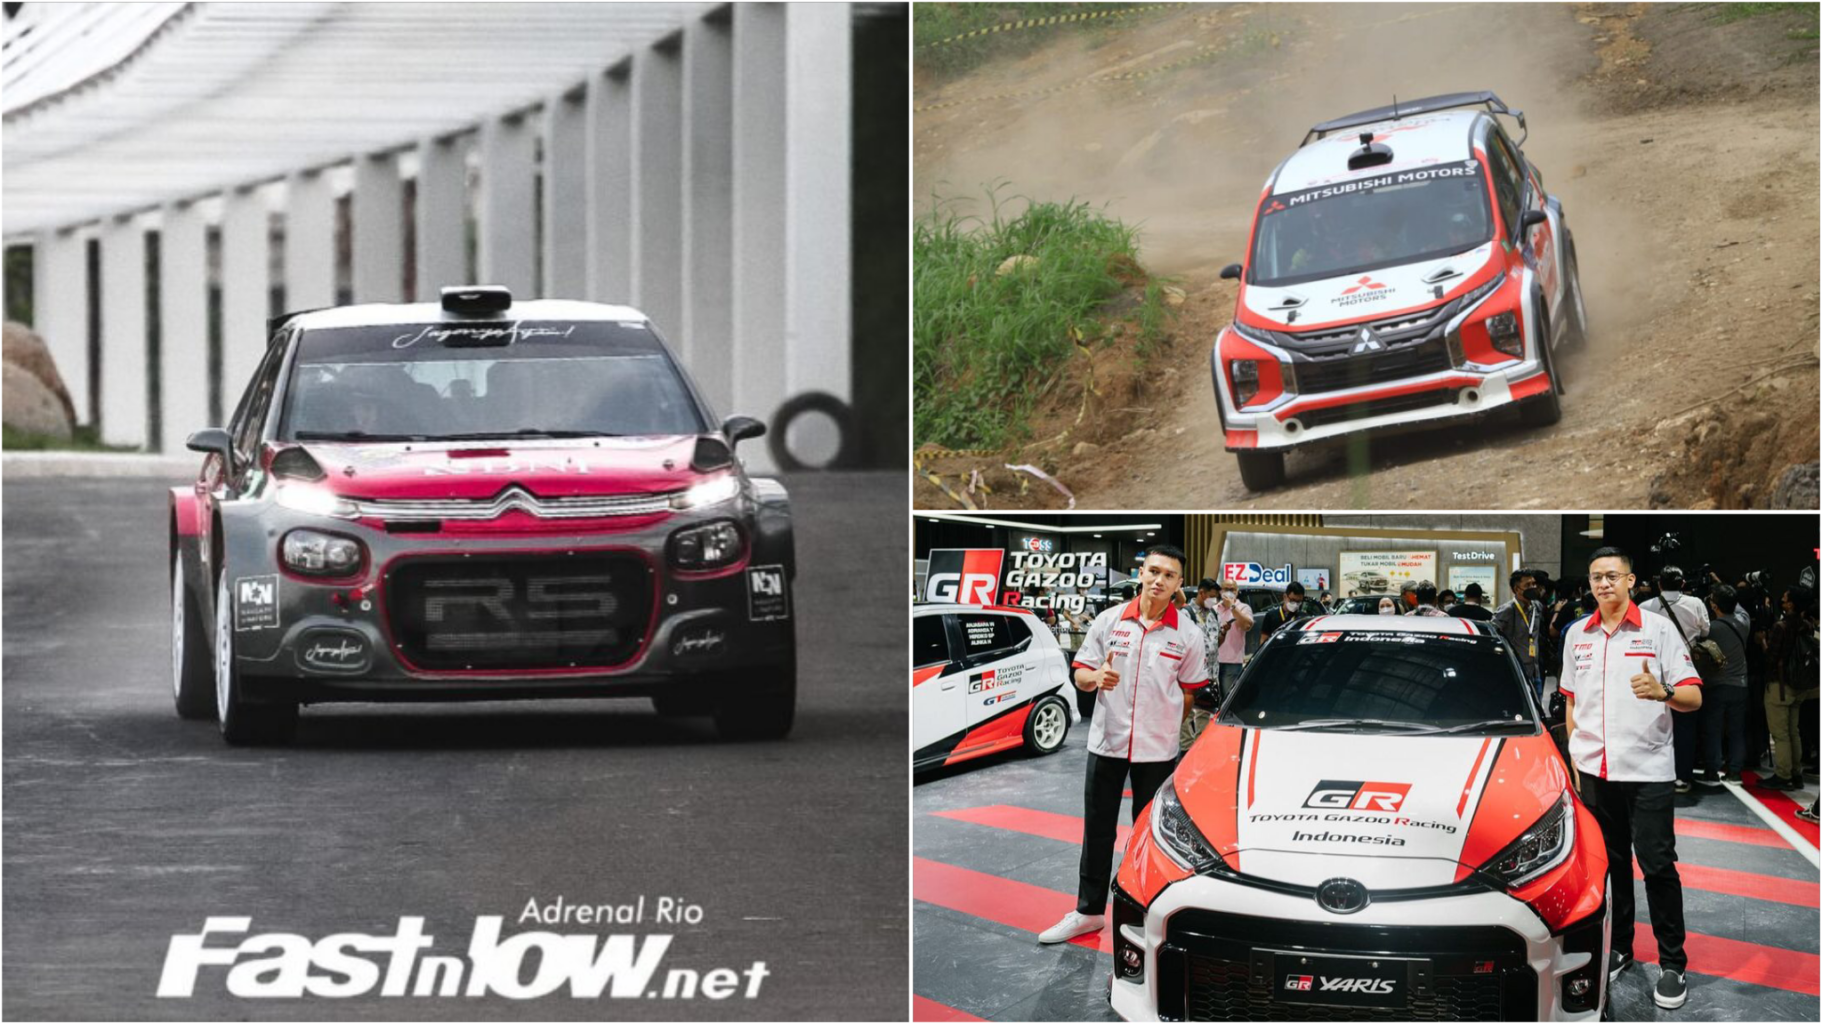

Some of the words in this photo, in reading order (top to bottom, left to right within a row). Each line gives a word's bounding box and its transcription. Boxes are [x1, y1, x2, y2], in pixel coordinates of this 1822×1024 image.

[1289, 176, 1392, 206] MITSUBISHI
[1398, 167, 1476, 182] MOTORS
[1331, 288, 1396, 304] MITSUBISHI
[1339, 294, 1386, 307] MOTORS
[1010, 552, 1107, 568] TOYOTA
[1006, 571, 1095, 588] GAZOO
[927, 573, 997, 606] GR
[1003, 591, 1085, 615] Racing
[1344, 636, 1425, 644] Indonesia
[1439, 635, 1478, 644] Racing
[997, 664, 1024, 674] TOYOTA
[997, 671, 1022, 680] GAZOO
[969, 677, 995, 694] GR
[997, 678, 1022, 687] Racing
[1307, 788, 1403, 811] GR
[1250, 814, 1318, 823] TOYOTA
[1324, 814, 1390, 824] GAZOO
[1394, 817, 1457, 834] Racing
[1292, 831, 1406, 847] Indonesia
[1285, 979, 1312, 990] GR
